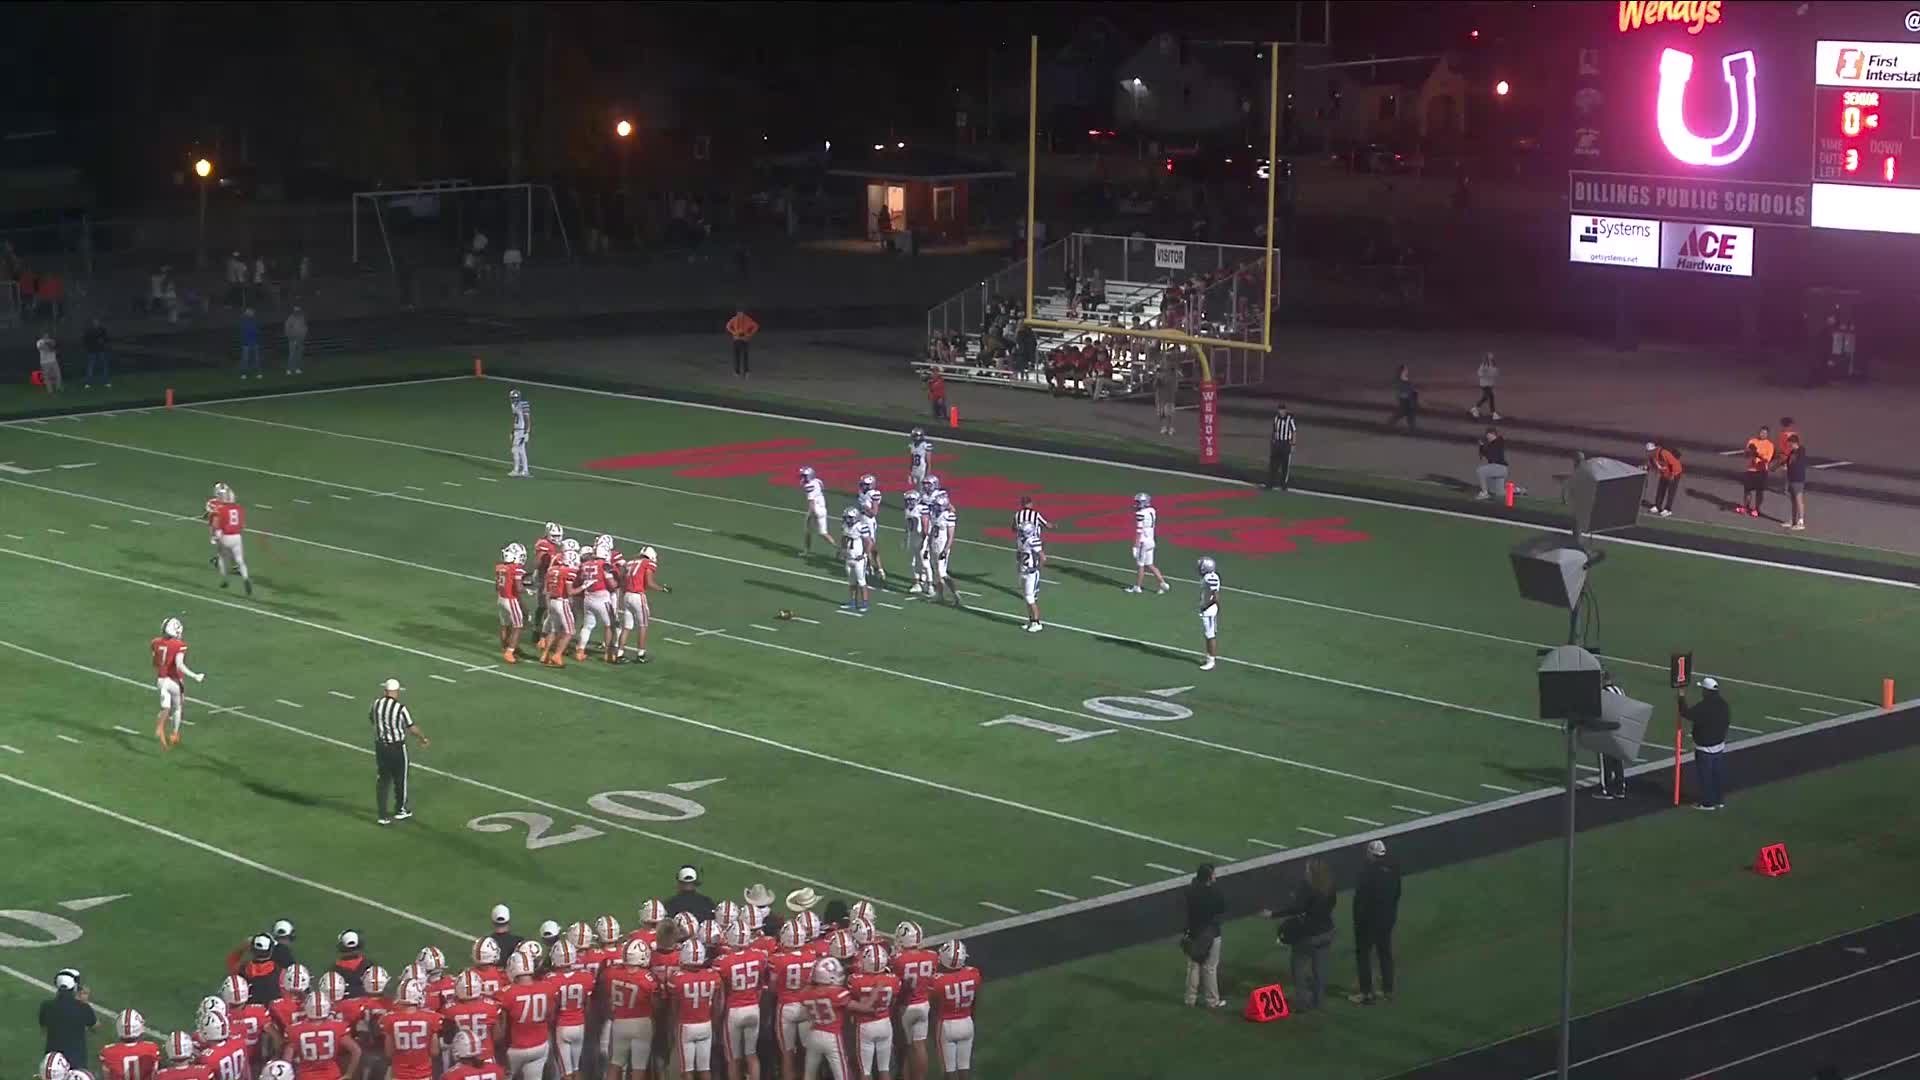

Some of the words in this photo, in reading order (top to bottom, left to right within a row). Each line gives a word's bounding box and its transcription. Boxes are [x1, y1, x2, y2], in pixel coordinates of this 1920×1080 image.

[1869, 54, 1898, 68] First
[1843, 91, 1880, 107] SENIOR
[1845, 148, 1859, 171] 3
[1870, 139, 1903, 155] DOWN
[1575, 181, 1650, 206] BILLINGS
[1656, 187, 1718, 211] PUBLIC
[1724, 191, 1806, 217] SCHOOLS
[1599, 218, 1651, 238] Systems
[1157, 248, 1184, 264] VISITOR
[1678, 226, 1738, 260] ACE
[1676, 259, 1733, 273] Hardware
[1202, 391, 1214, 456] WENDYS
[228, 508, 240, 526] 8
[158, 646, 168, 665] 7
[1677, 656, 1686, 682] 1
[979, 696, 1193, 743] 10
[466, 790, 706, 850] 20
[1767, 848, 1787, 873] 10
[731, 961, 761, 991] 65
[559, 983, 584, 1011] 19
[610, 979, 641, 1010] 67
[683, 980, 716, 1010] 44
[944, 980, 976, 1008] 45
[1260, 989, 1285, 1018] 20
[516, 993, 548, 1024] 70
[300, 1030, 336, 1061] 63
[392, 1020, 428, 1050] 62
